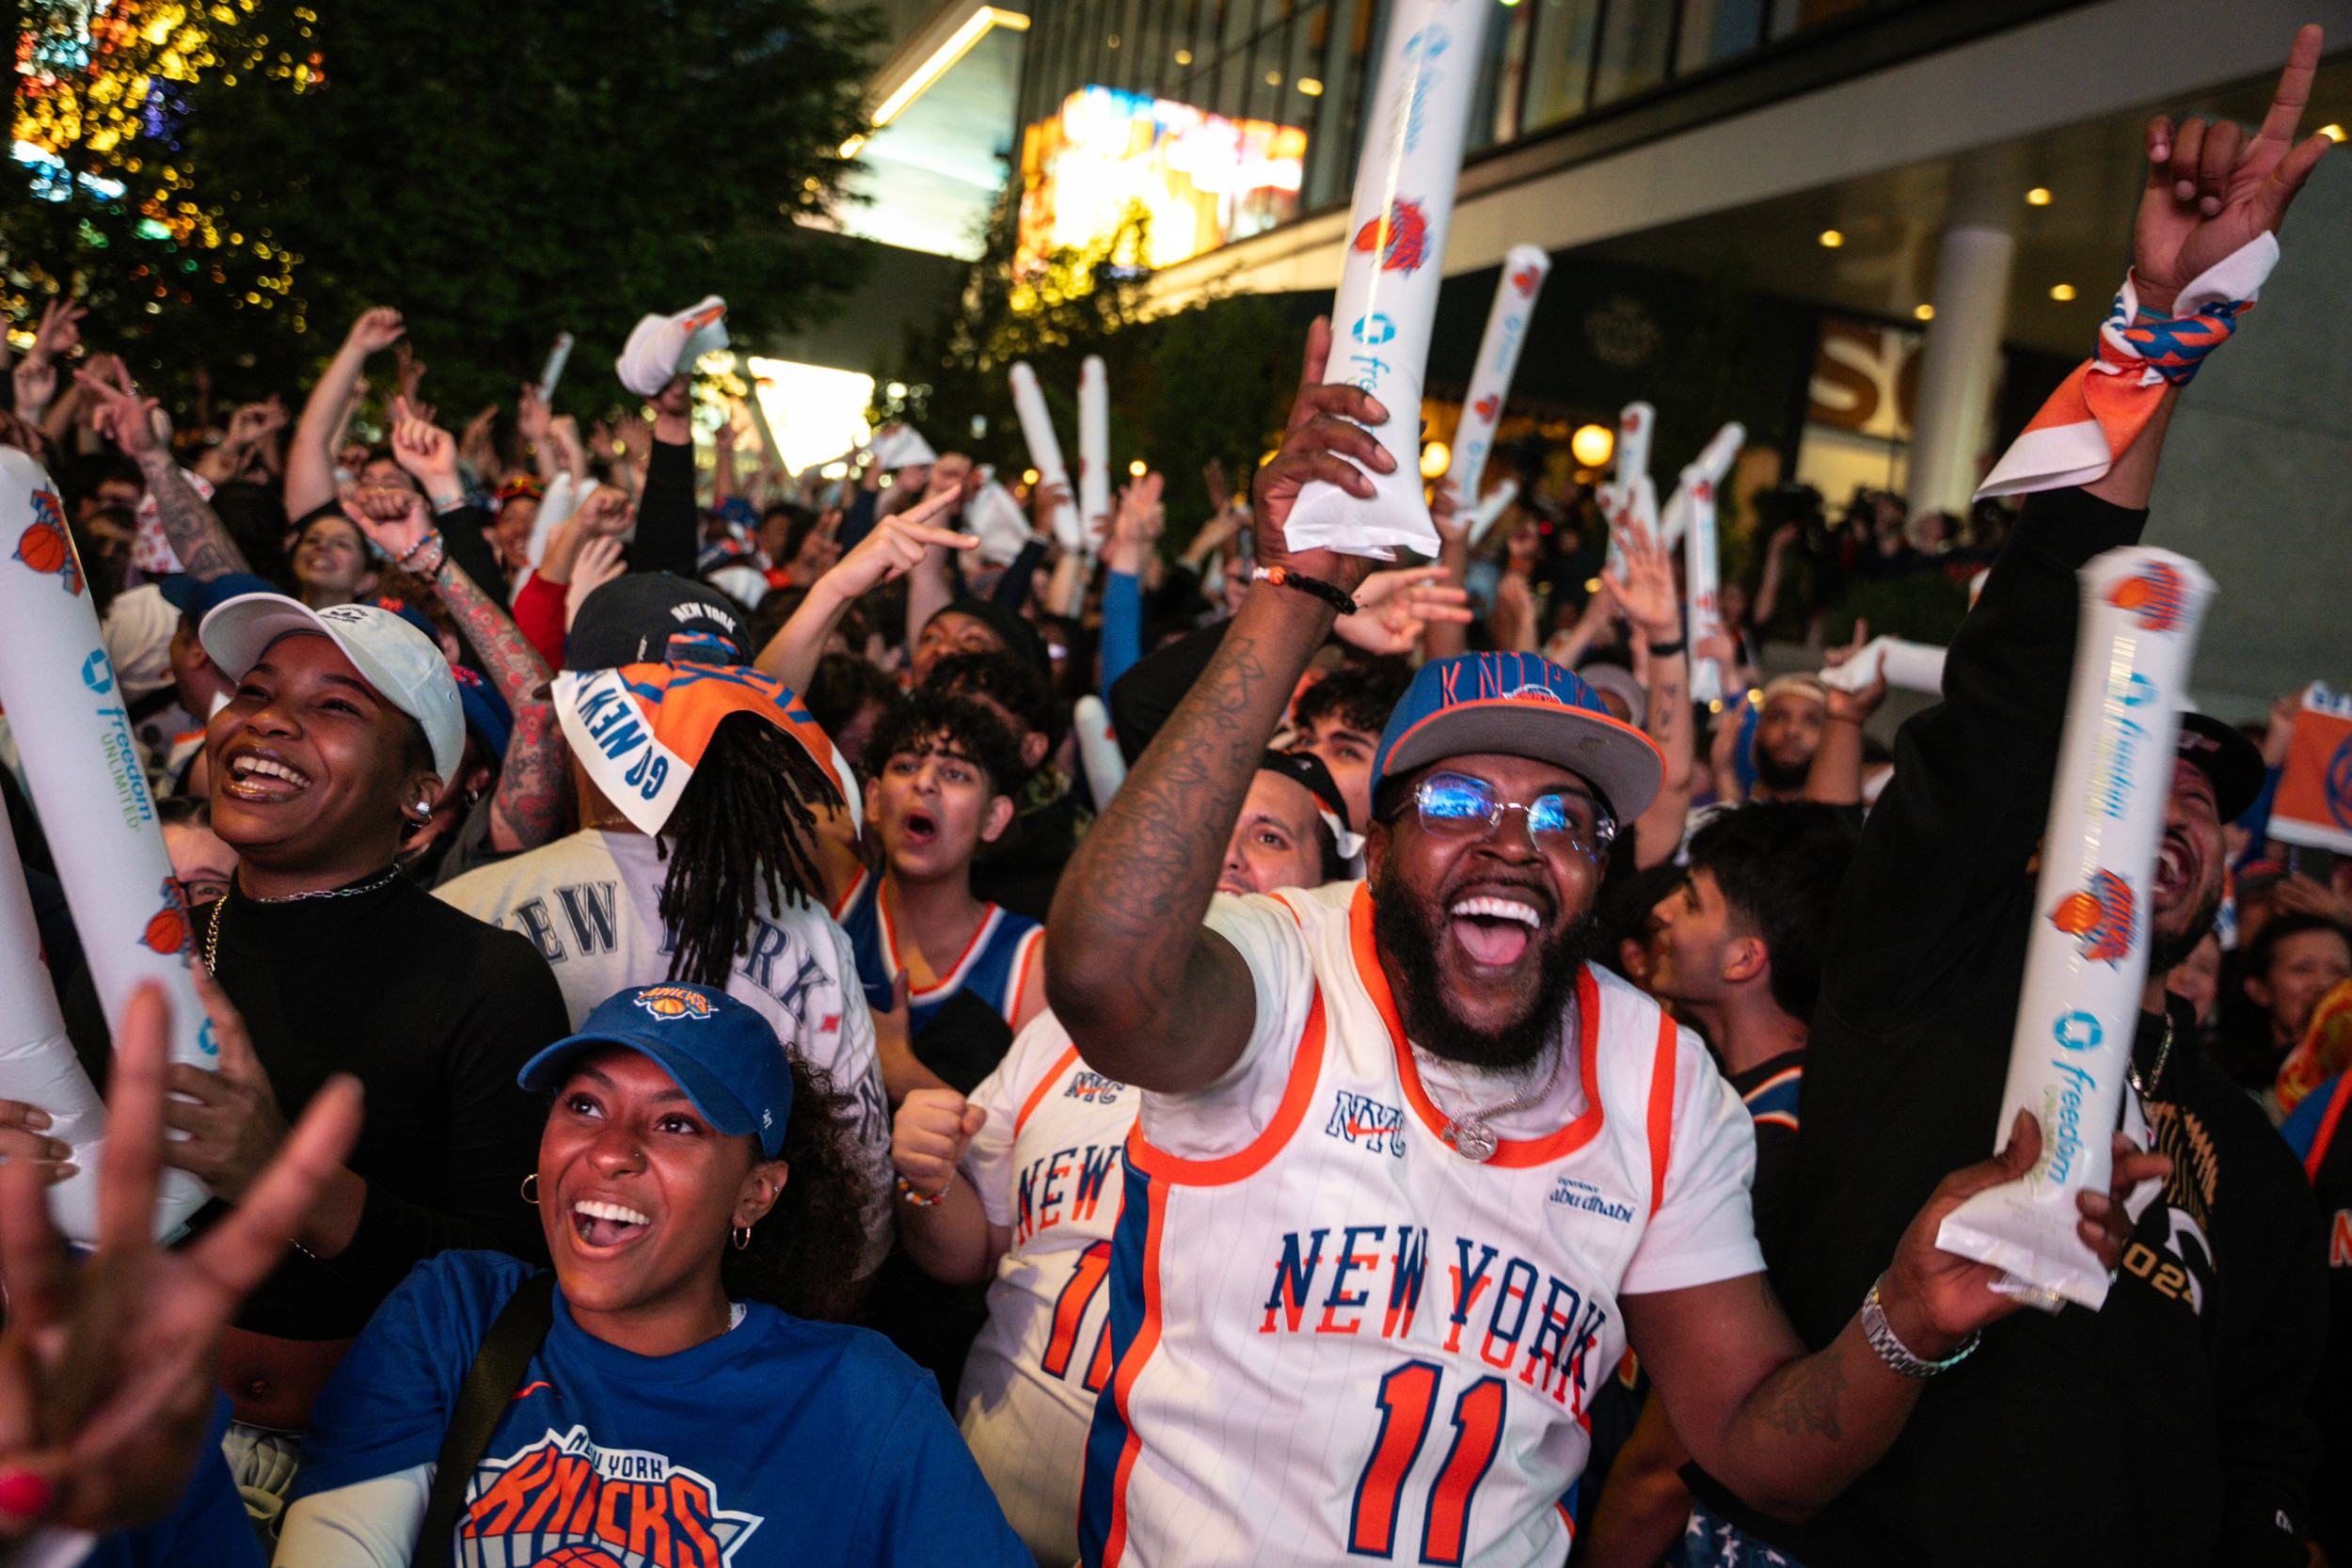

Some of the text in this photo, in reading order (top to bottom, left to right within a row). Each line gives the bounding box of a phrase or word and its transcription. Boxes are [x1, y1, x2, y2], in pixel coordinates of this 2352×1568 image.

[670, 602, 738, 635] NEW YORK
[577, 688, 649, 761] NEW
[96, 705, 153, 822] freedom
[624, 744, 670, 801] GO
[491, 880, 618, 965] EW
[638, 987, 708, 1015] KNICKS
[1064, 1070, 1125, 1105] NYC
[1325, 1089, 1406, 1159] NYC
[2048, 1058, 2097, 1185] freedom
[1018, 1145, 1123, 1247] NEW
[1549, 1188, 1636, 1224] abu dhabi
[2122, 1238, 2199, 1313] 02
[1259, 1226, 1607, 1417] NEW YORK
[610, 1453, 664, 1481] YORK
[1347, 1359, 1508, 1568] 11
[463, 1446, 721, 1568] KNICKS
